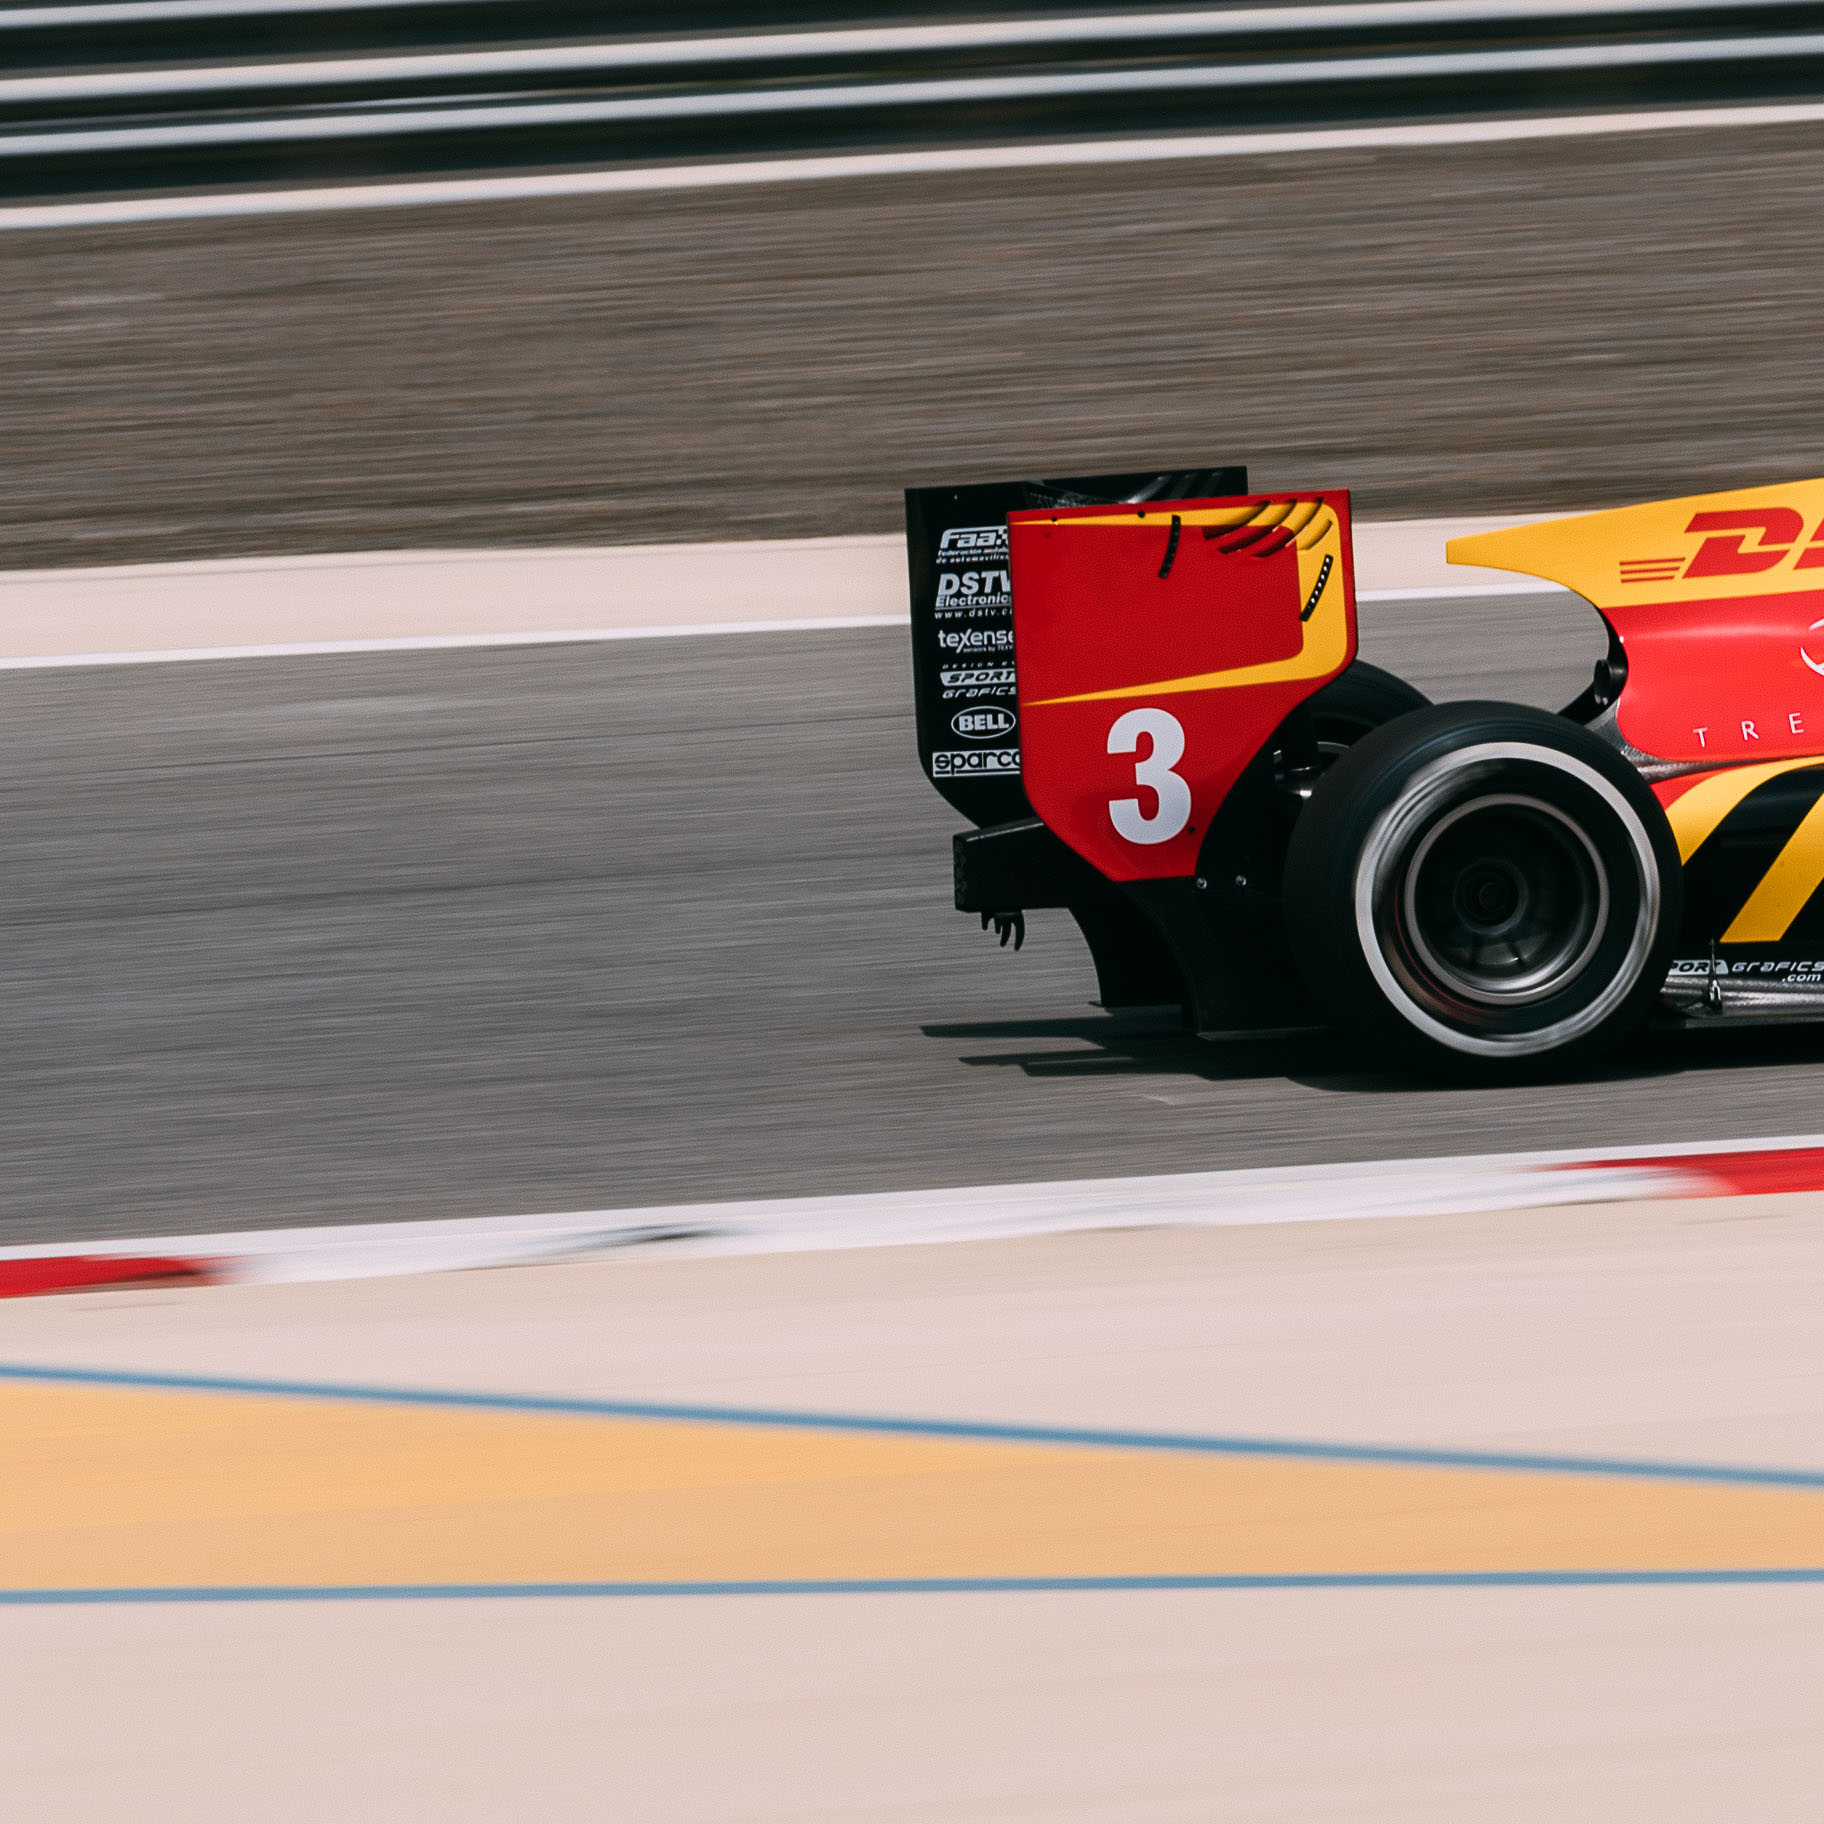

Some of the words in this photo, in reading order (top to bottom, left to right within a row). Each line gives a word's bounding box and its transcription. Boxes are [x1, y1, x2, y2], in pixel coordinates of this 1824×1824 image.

[958, 713, 1009, 731] BELL
[1106, 707, 1191, 845] 3
[1781, 973, 1821, 983] .com
